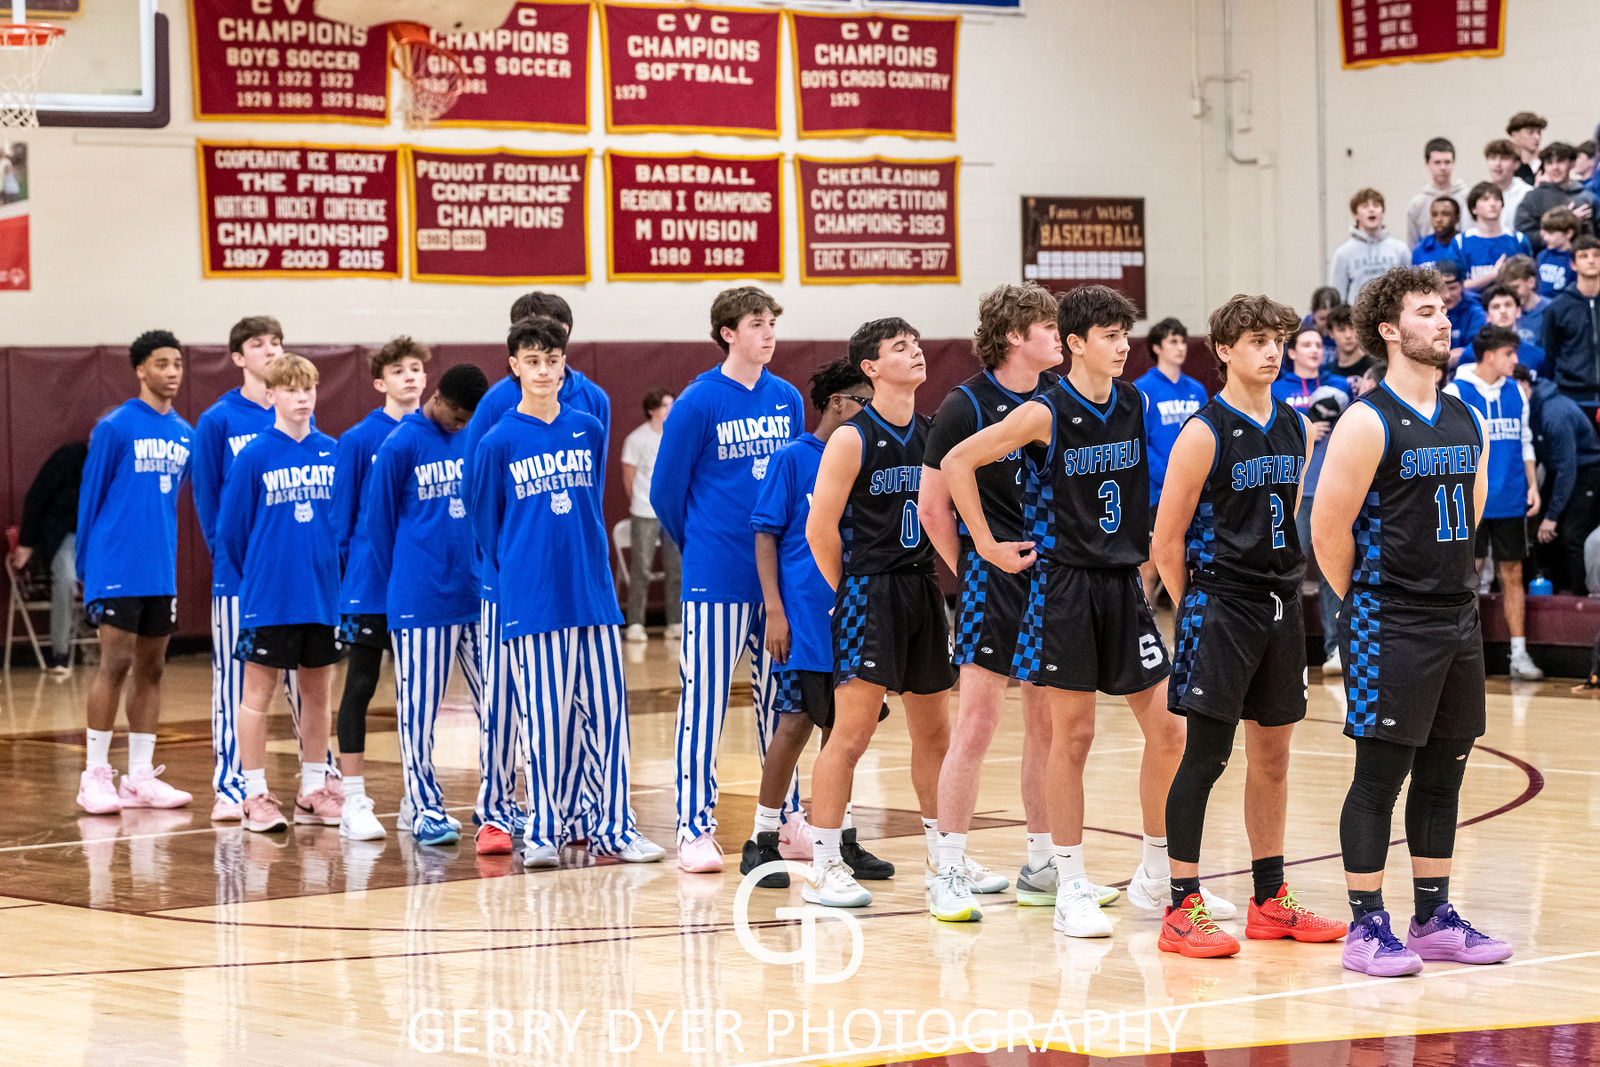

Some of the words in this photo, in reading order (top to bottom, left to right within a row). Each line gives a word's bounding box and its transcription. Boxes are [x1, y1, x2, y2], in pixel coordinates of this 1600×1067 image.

[218, 17, 368, 46] CHAMPIONS
[226, 47, 279, 67] BOYS
[286, 49, 360, 70] SOCCER
[627, 35, 760, 62] CHAMPIONS
[814, 44, 937, 68] CHAMPIONS
[236, 70, 270, 86] 1971
[495, 56, 571, 78] SOCCER
[635, 62, 753, 85] SOFTBALL
[801, 70, 838, 88] BOYS
[840, 70, 886, 88] CROSS
[888, 70, 951, 92] COUNTRY
[215, 149, 300, 170] COOPERATIVE
[307, 151, 329, 171] ICE
[335, 152, 386, 173] HOCKEY
[416, 159, 487, 182] PEQUOT
[493, 162, 581, 183] FOOTBALL
[237, 172, 287, 192] THE
[297, 174, 367, 195] FIRST
[635, 164, 755, 185] BASEBALL
[817, 167, 940, 187] CHEERLEADING
[431, 182, 572, 203] CONFERENCE
[620, 189, 672, 212] REGION
[676, 190, 687, 212] I
[694, 190, 772, 213] CHAMPIONS
[810, 189, 844, 210] CVC
[847, 188, 948, 211] COMPETITION
[323, 198, 387, 222] CONFERENCE
[437, 203, 564, 229] CHAMPIONS
[217, 222, 389, 247] CHAMPIONSHIP
[635, 218, 652, 241] M
[661, 218, 758, 242] DIVISION
[1040, 223, 1143, 247] BASKETBALL
[281, 249, 329, 269] 2003
[338, 249, 385, 270] 2015
[716, 415, 790, 445] WILDCATS
[718, 439, 789, 460] BASKETBA
[262, 465, 335, 492] WILDCATS
[509, 449, 592, 484] WILDCATS
[515, 472, 593, 500] BASKETBALL
[1097, 480, 1122, 534] 3
[1434, 483, 1469, 542] 11
[900, 499, 920, 548] 0
[1269, 493, 1286, 549] 2
[1138, 633, 1163, 669] S
